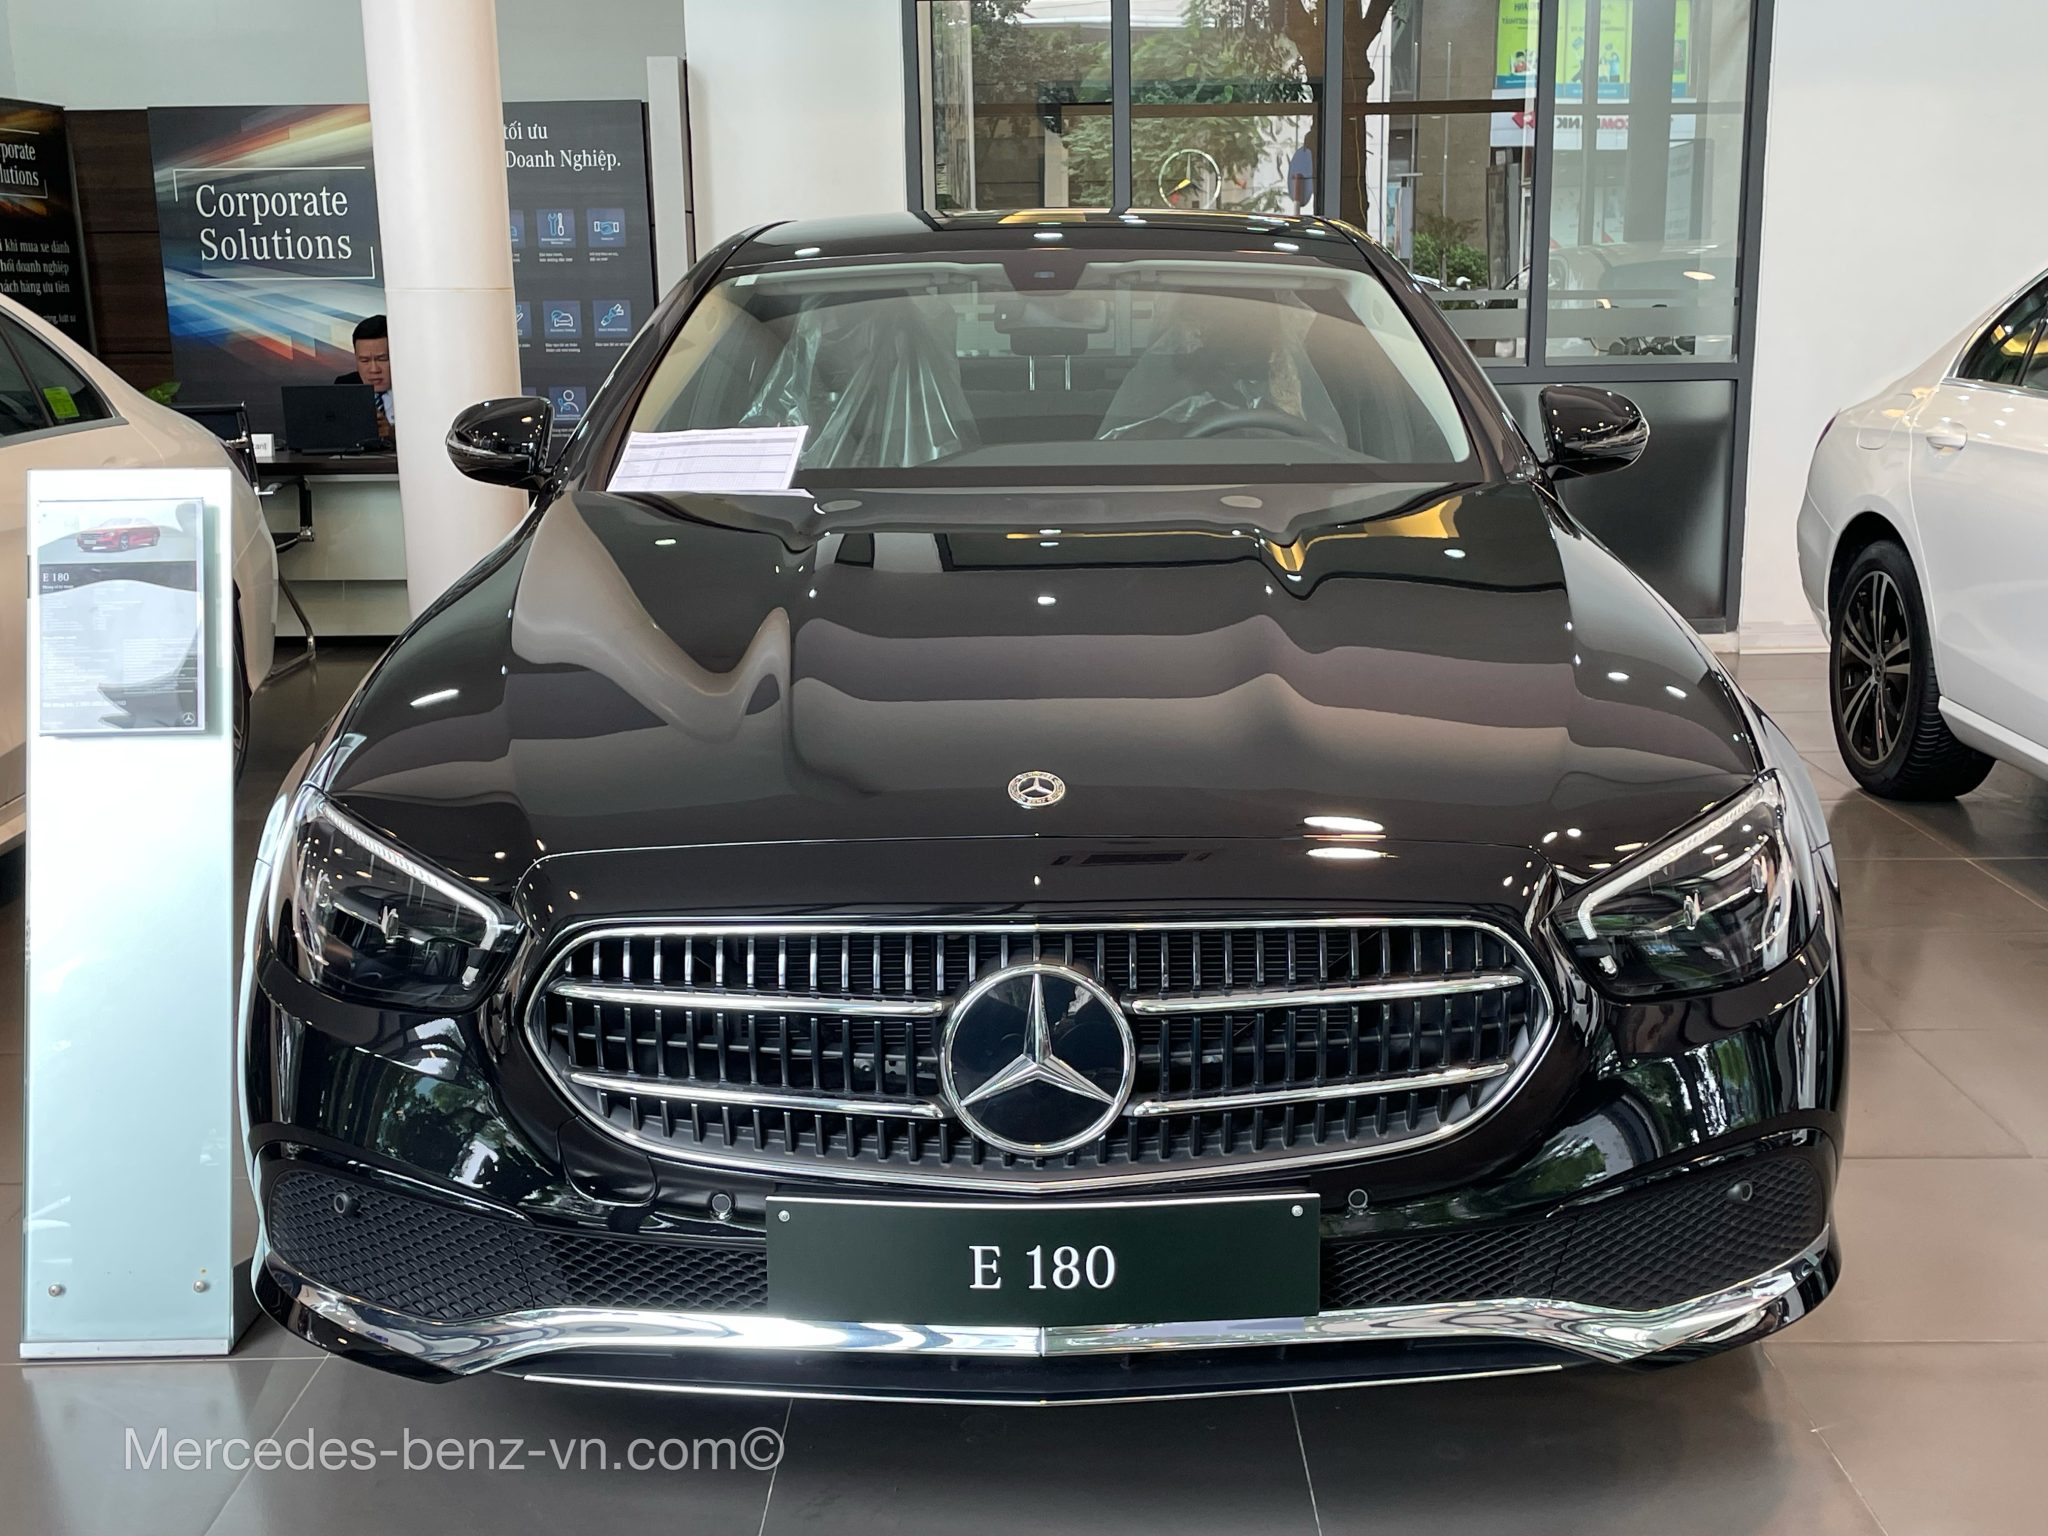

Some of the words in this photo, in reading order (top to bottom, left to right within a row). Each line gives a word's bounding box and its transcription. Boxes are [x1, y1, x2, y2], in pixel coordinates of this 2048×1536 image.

[503, 120, 523, 140] tối
[527, 123, 549, 140] ưu
[0, 142, 36, 163] porate
[505, 150, 556, 168] Doanh
[560, 149, 622, 172] Nghiệp.
[195, 184, 349, 226] Corporate
[20, 242, 39, 253] mua
[200, 227, 353, 262] Solutions
[16, 259, 42, 273] doanh
[43, 572, 49, 582] E
[53, 572, 70, 582] 180
[968, 1244, 1002, 1290] E
[1026, 1243, 1117, 1290] 180
